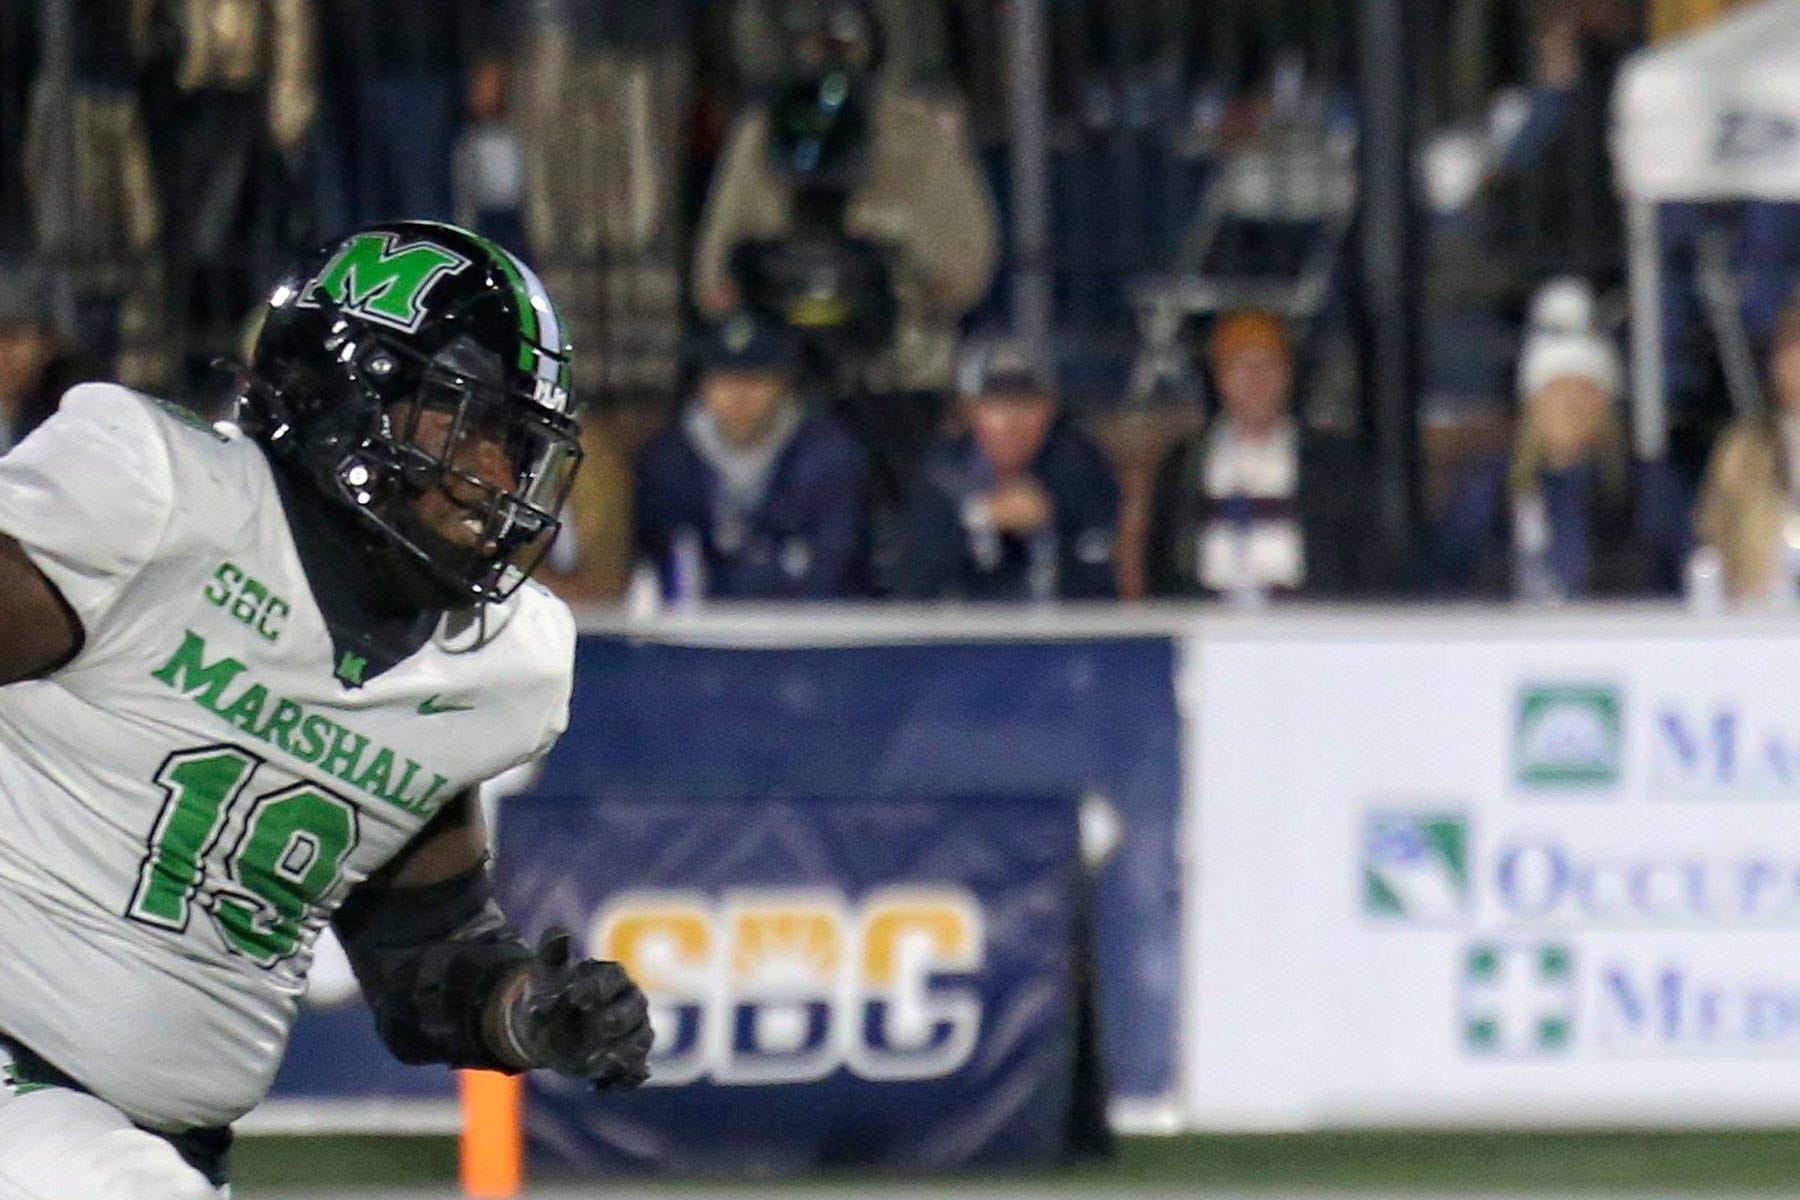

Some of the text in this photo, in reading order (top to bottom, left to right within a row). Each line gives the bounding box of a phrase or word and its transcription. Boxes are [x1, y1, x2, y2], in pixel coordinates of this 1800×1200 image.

[296, 231, 473, 334] M
[204, 562, 291, 642] SBC
[150, 629, 448, 817] MARSHALL
[125, 742, 362, 971] 19
[589, 884, 985, 1086] SBC
